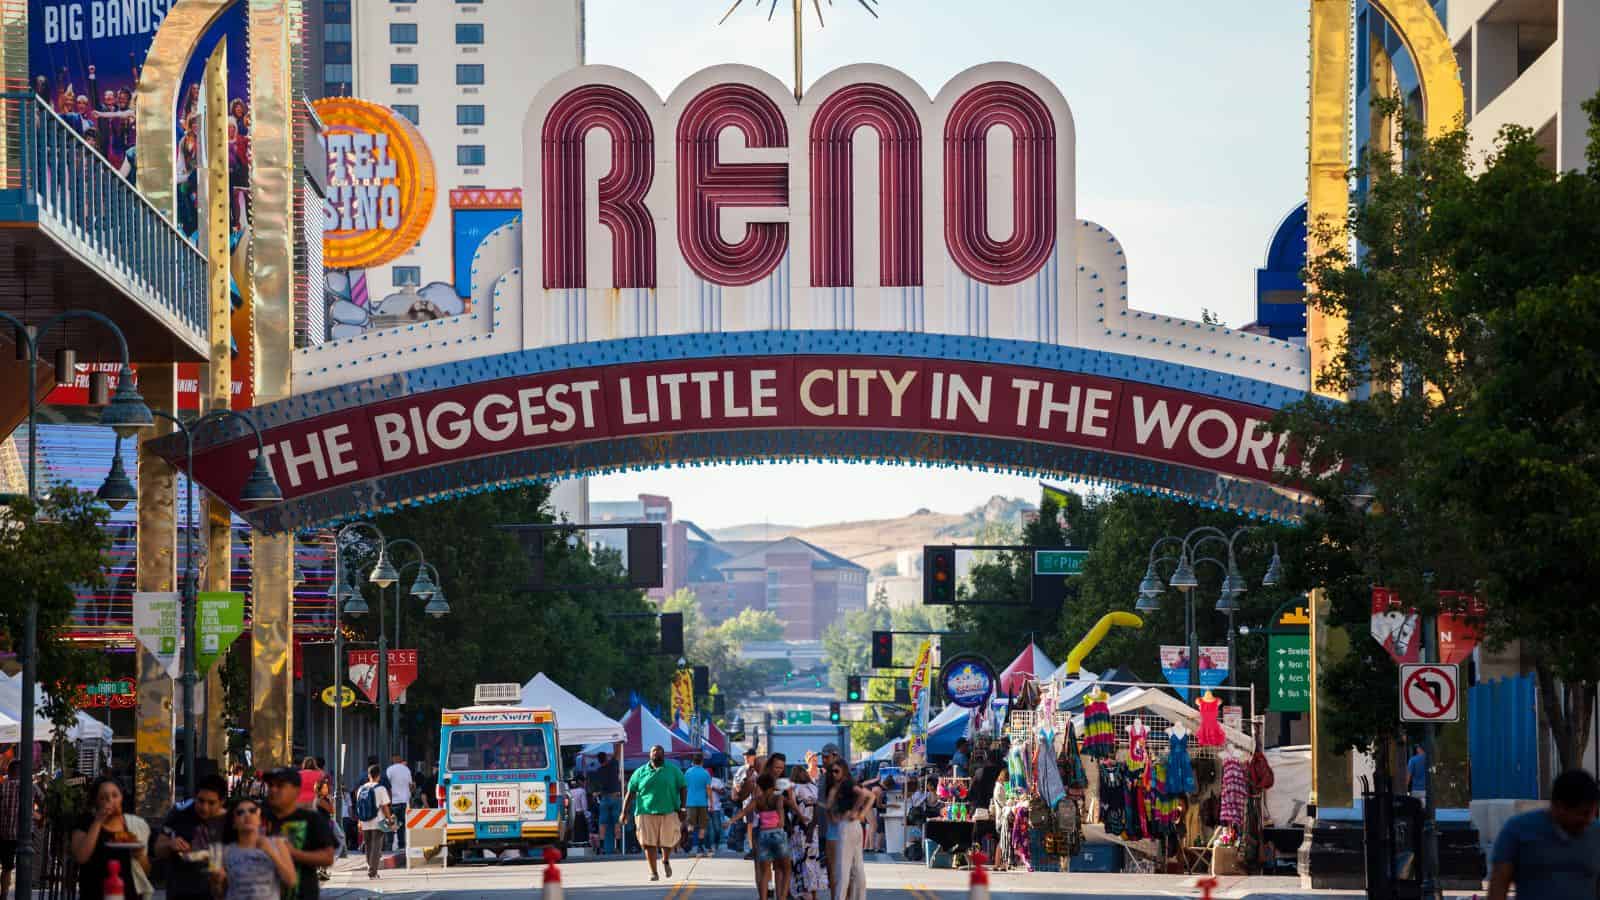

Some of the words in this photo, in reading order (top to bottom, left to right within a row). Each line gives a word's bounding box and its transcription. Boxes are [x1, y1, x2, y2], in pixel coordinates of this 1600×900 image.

[45, 3, 83, 44] BIG
[541, 80, 1057, 289] RENO
[248, 423, 359, 488] THE
[374, 380, 600, 462] BIGGEST
[619, 369, 778, 424] LITTLE
[799, 368, 918, 417] CITY
[930, 371, 993, 423] IN
[1012, 378, 1113, 437] THE
[481, 805, 516, 814] CAREFULLY
